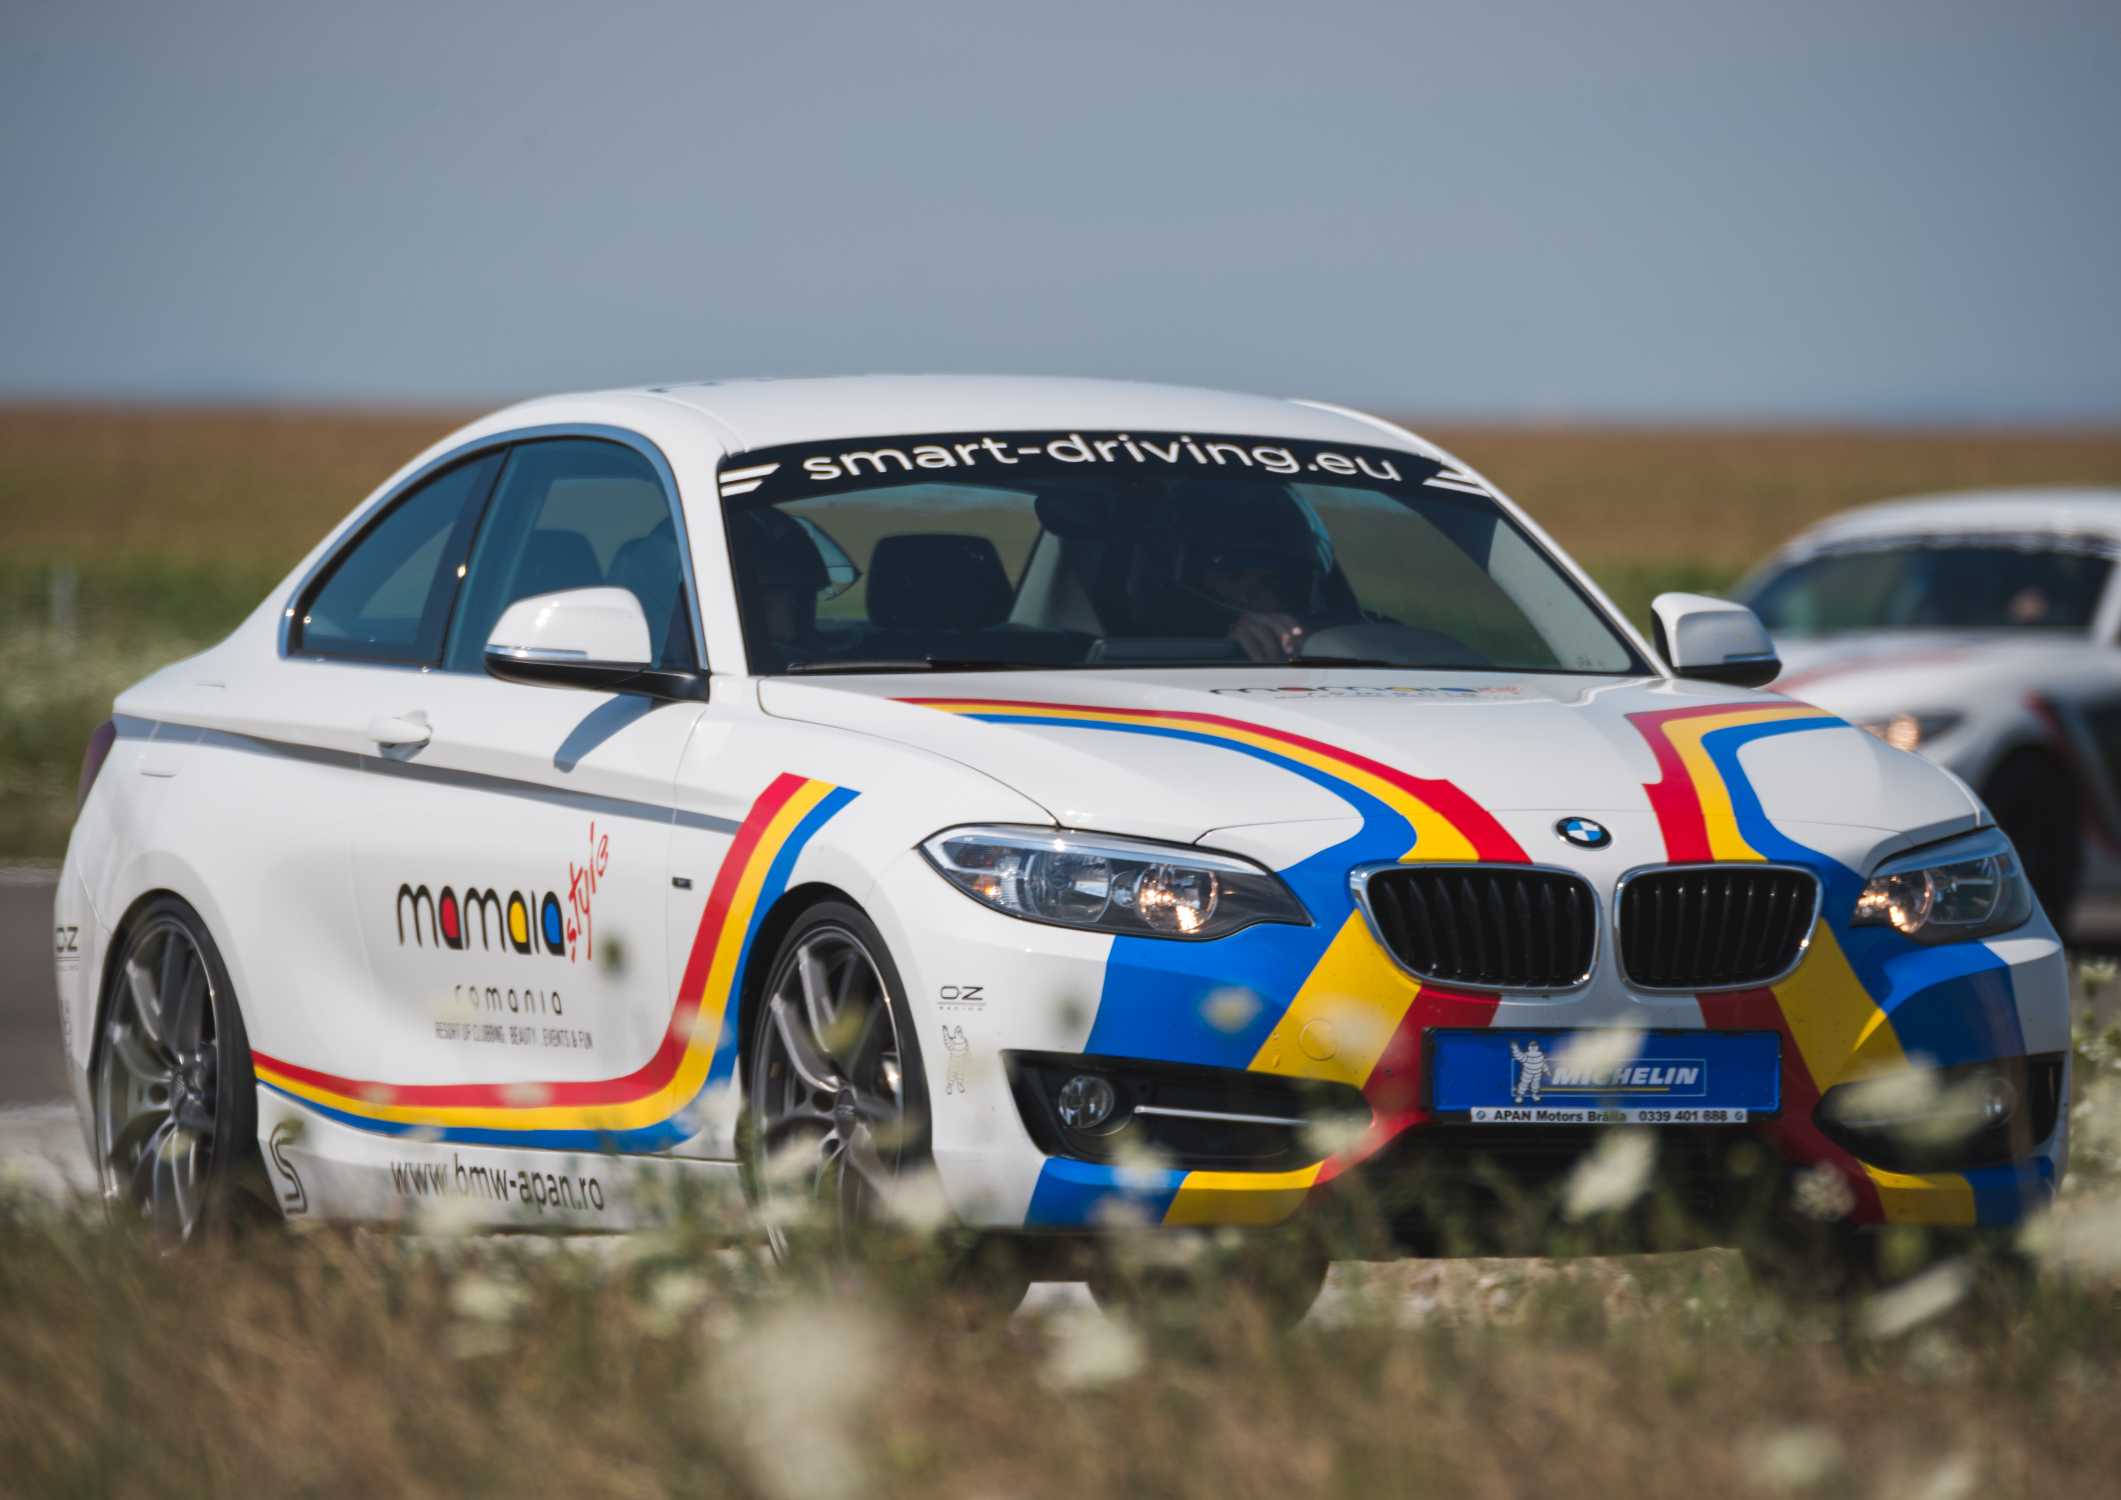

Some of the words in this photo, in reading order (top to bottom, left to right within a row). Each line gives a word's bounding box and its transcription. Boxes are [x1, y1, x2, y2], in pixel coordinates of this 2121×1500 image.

[802, 434, 1402, 482] smart-driving.eu
[396, 883, 566, 956] mamaia
[1494, 1110, 1532, 1121] APAN
[1536, 1110, 1583, 1122] Motors
[1639, 1110, 1671, 1121] 0339
[1675, 1110, 1698, 1121] 401
[391, 1152, 604, 1212] wwwbmw-apan.ro
